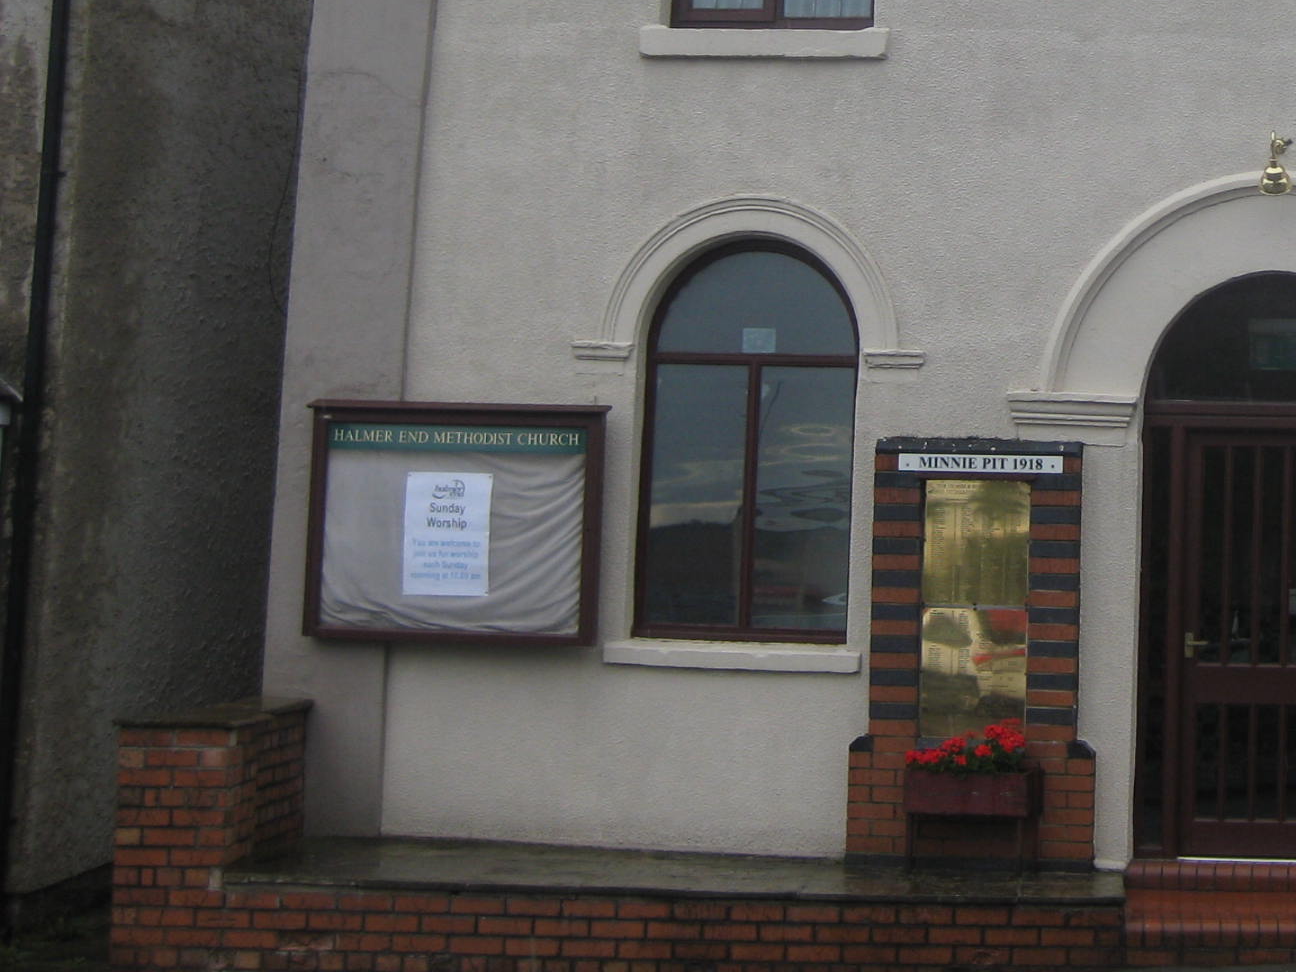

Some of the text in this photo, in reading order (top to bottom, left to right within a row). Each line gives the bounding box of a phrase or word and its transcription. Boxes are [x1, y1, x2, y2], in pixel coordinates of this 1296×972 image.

[334, 428, 580, 446] HALMER END METHODIST CHURCH
[919, 456, 1044, 470] MINNIE PIT 1918
[429, 502, 466, 515] Sunday
[426, 516, 468, 530] Worship
